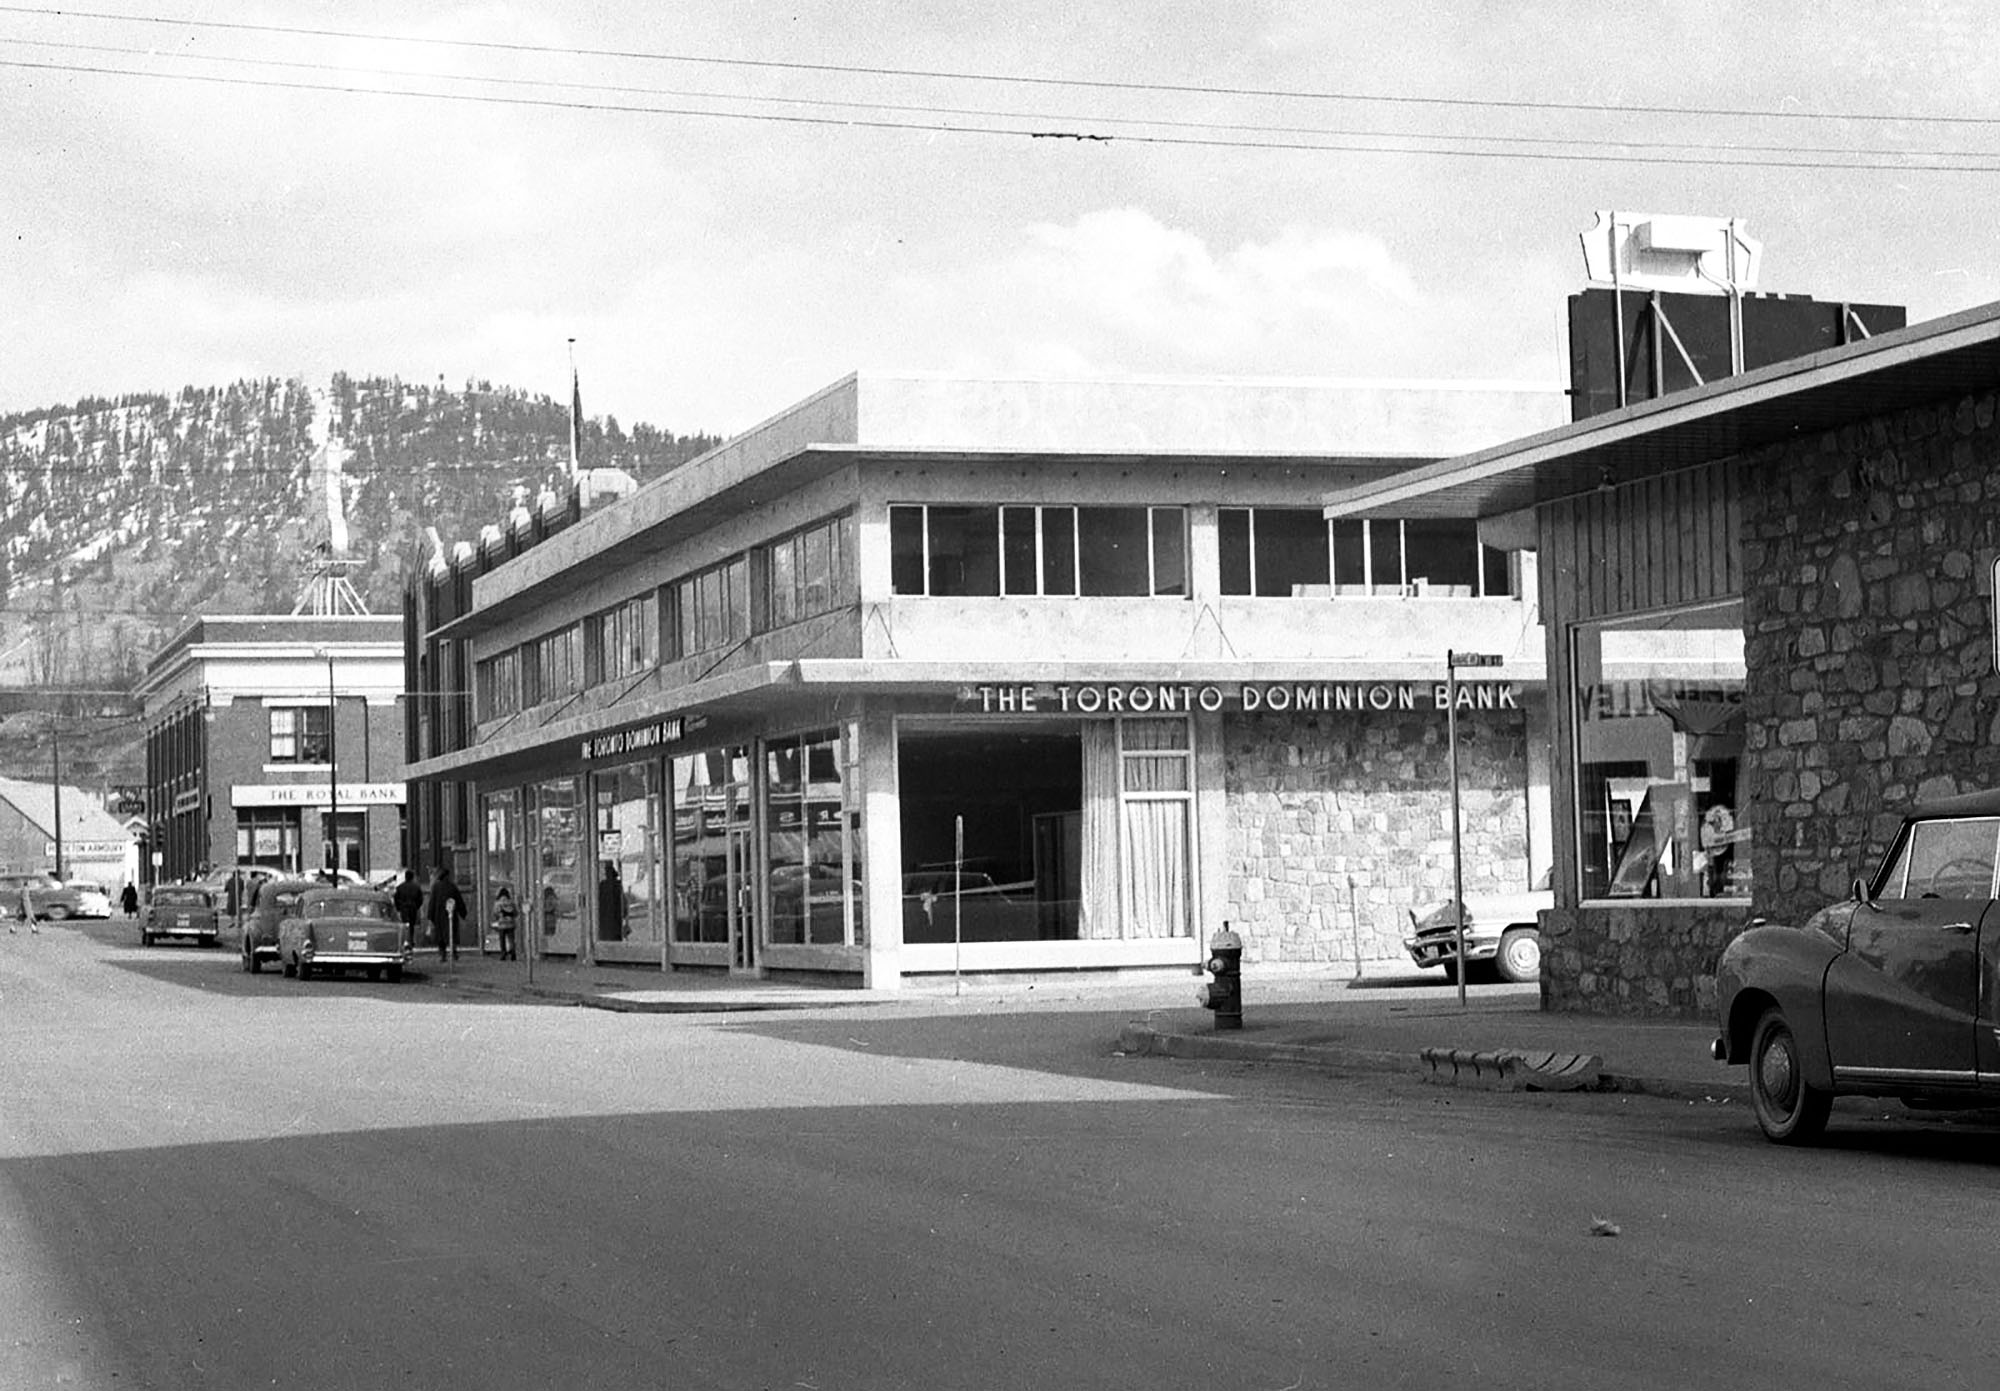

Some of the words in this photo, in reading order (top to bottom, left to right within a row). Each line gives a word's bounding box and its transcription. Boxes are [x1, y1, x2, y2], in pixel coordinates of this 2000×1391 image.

[979, 686, 1037, 712] THE
[1055, 686, 1223, 712] TORONTO
[1243, 686, 1414, 710] DOMINION
[1435, 685, 1518, 710] BANK
[271, 789, 297, 800] THE
[306, 789, 351, 800] ROAL
[360, 788, 397, 799] BANK
